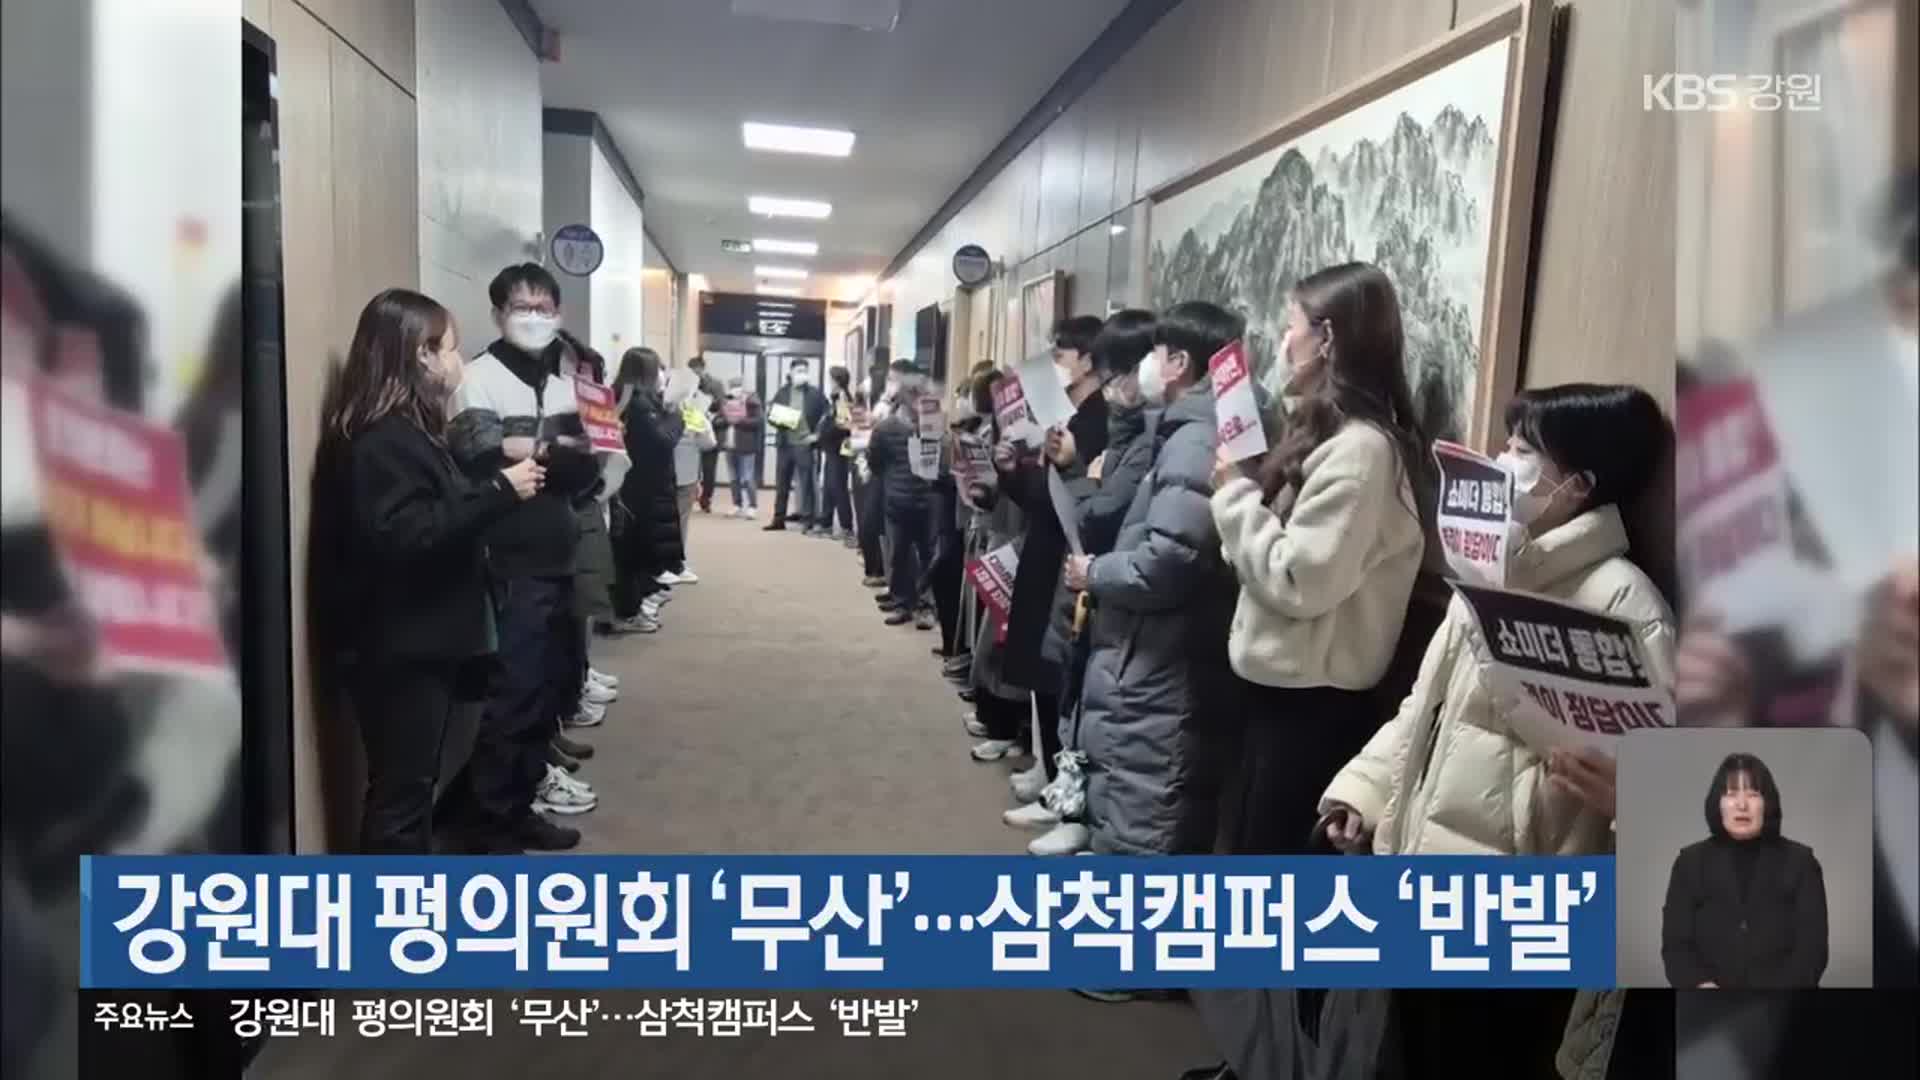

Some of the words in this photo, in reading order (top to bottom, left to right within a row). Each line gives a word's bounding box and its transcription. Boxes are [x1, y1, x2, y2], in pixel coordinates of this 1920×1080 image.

[1446, 479, 1480, 514] 쇼미더
[1496, 618, 1570, 668] 쇼미더
[1567, 627, 1646, 678] 통합!
